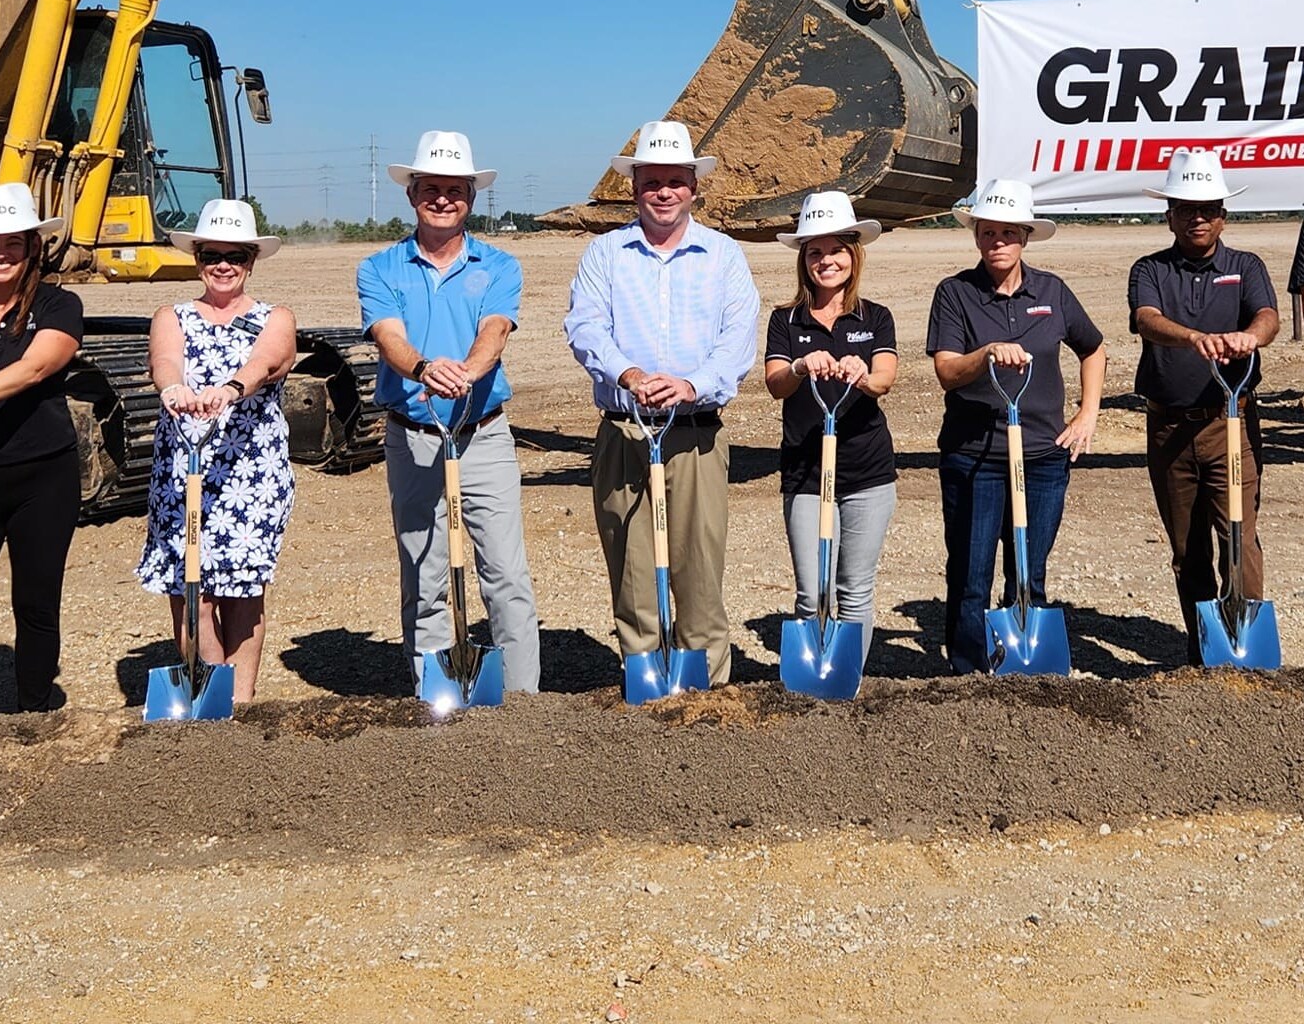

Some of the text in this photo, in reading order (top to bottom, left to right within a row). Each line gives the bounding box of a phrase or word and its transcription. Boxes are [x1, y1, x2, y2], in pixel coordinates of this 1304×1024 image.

[1212, 144, 1258, 161] THE
[1182, 172, 1212, 182] HTDC
[985, 195, 1015, 207] HTDC
[805, 210, 834, 221] HTDC
